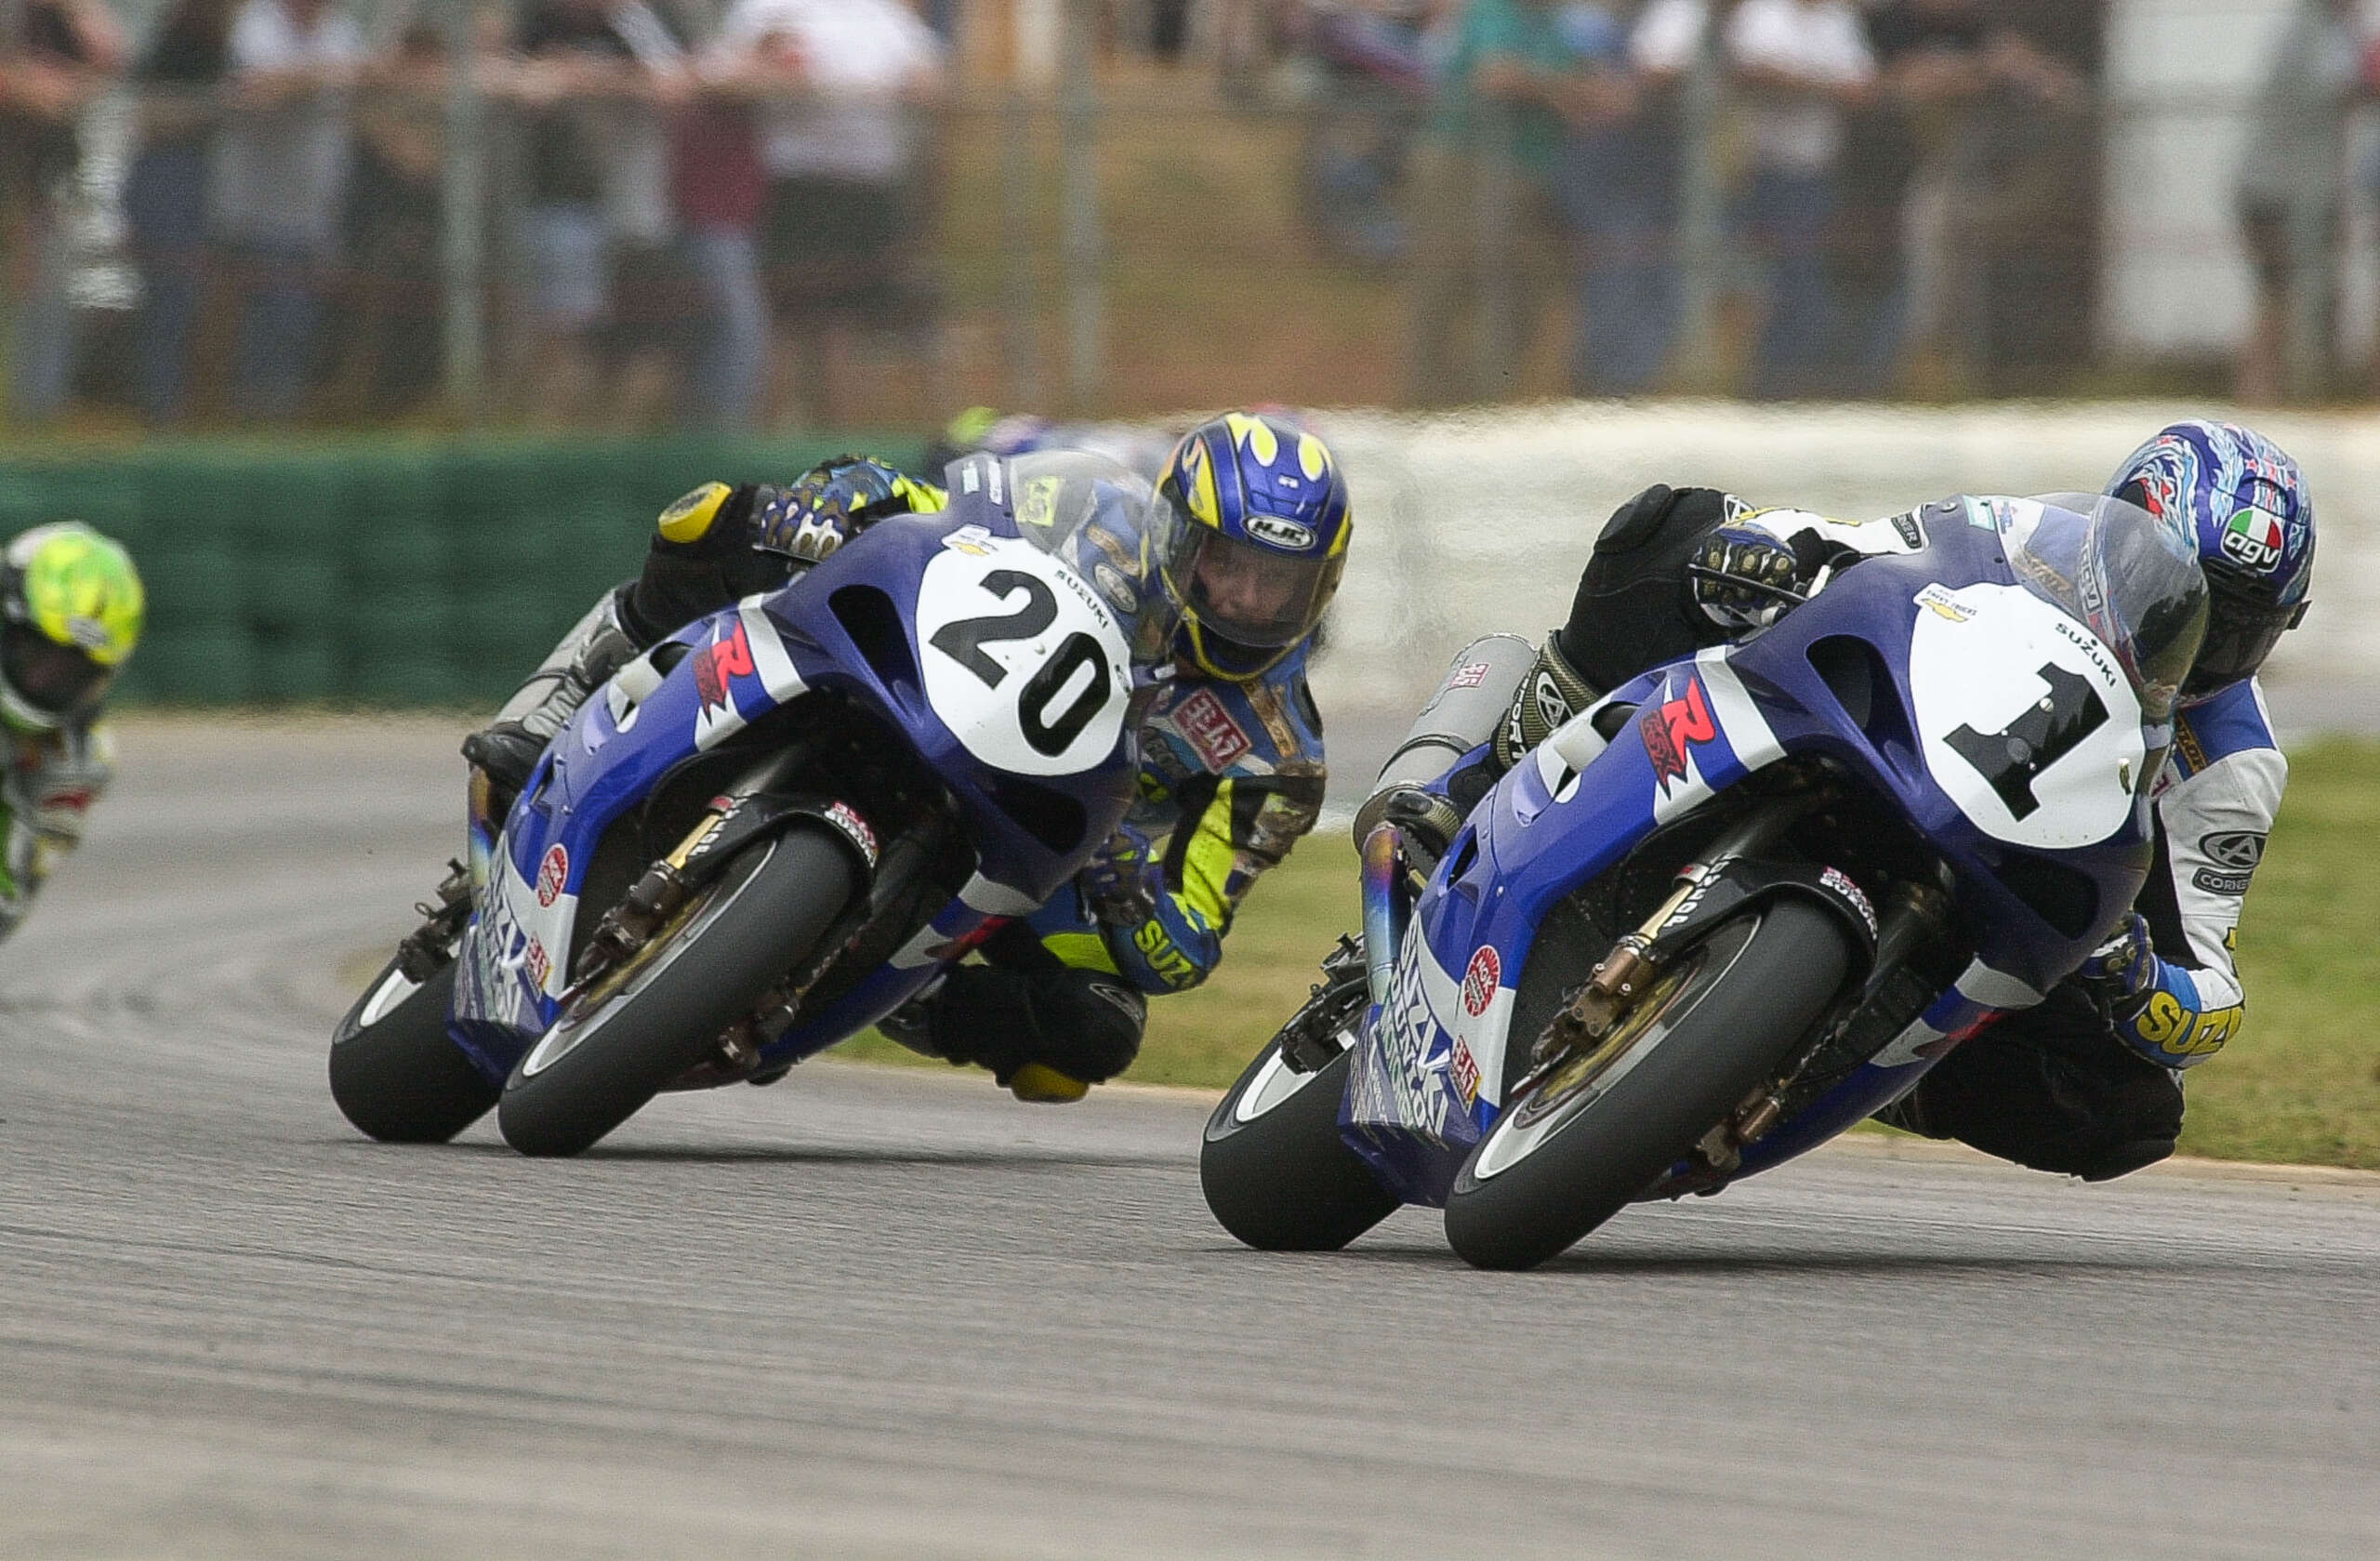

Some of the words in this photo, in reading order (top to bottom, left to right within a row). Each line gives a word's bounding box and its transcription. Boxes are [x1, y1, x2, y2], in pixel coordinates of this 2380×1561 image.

[1250, 519, 1306, 545] HJC
[1055, 569, 1109, 630] SUZUKI
[930, 569, 1113, 759] 20
[2055, 622, 2118, 688] SUZUKI
[1943, 662, 2110, 823] 1
